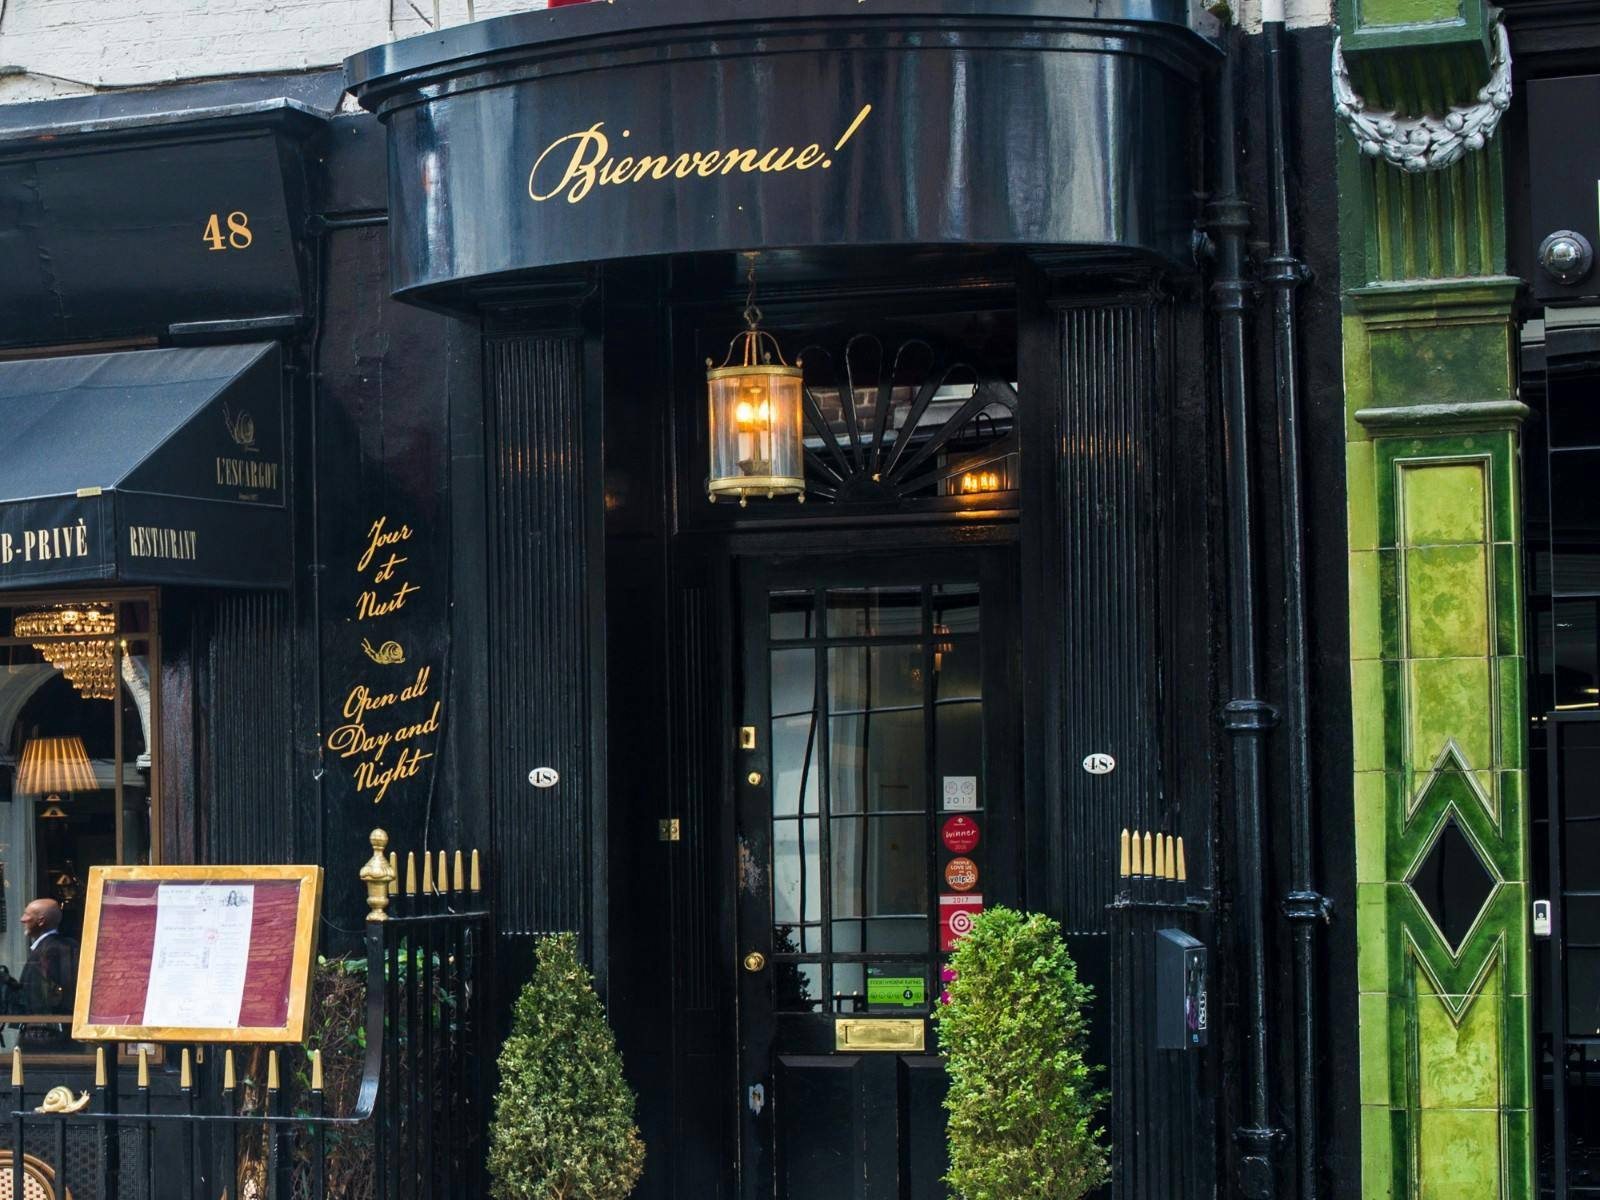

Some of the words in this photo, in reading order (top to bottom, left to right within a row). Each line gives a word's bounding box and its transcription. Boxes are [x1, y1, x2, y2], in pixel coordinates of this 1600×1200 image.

[529, 104, 871, 203] Bienvenue!
[203, 211, 252, 250] 48
[216, 456, 278, 490] L'ESCARGOT
[129, 525, 198, 561] RESTAURANT
[357, 516, 413, 572] Jour
[374, 553, 408, 584] et
[356, 582, 421, 621] Nuit
[343, 685, 398, 724] Open
[400, 665, 430, 703] all
[327, 723, 392, 761] Day
[394, 701, 441, 741] and
[353, 748, 433, 804] Night
[946, 796, 973, 804] 2017
